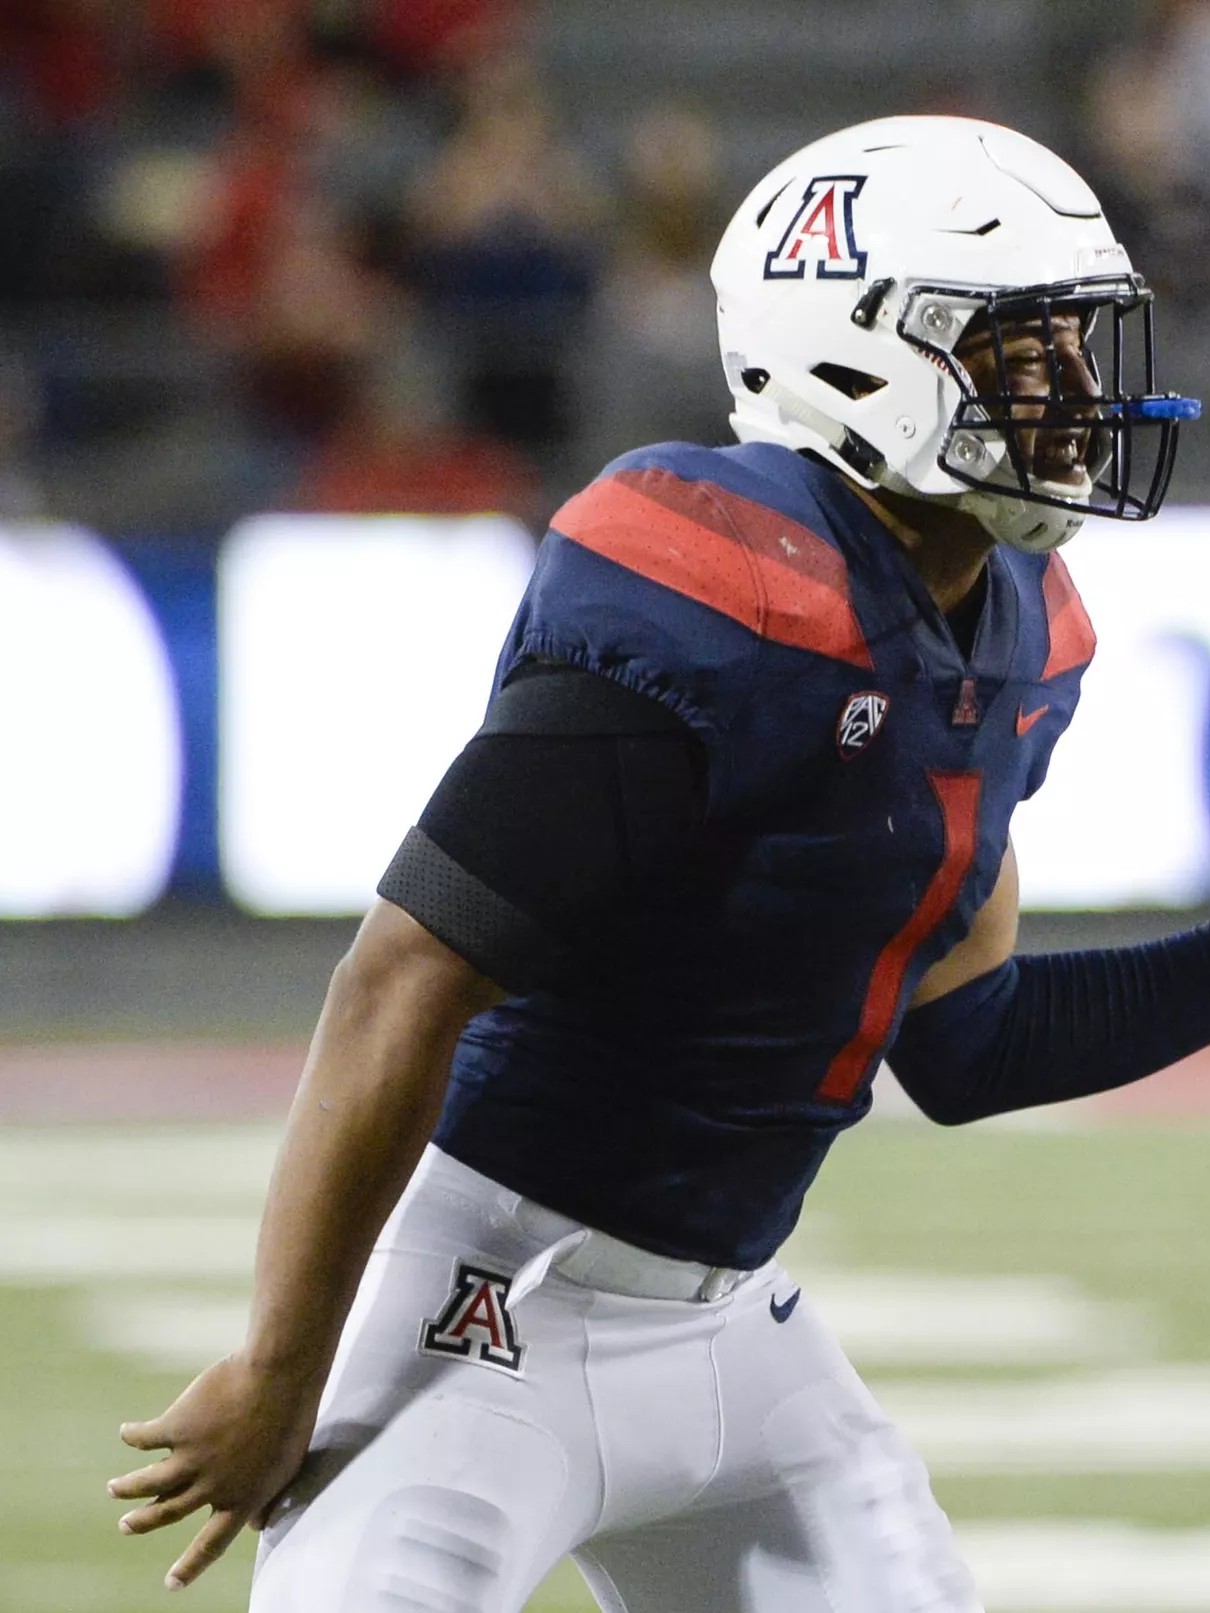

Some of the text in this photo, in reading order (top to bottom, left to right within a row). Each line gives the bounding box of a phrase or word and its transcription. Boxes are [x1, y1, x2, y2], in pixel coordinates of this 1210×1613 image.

[763, 175, 868, 281] A
[840, 695, 887, 736] PAC
[841, 721, 870, 747] 12
[420, 1262, 526, 1375] A
